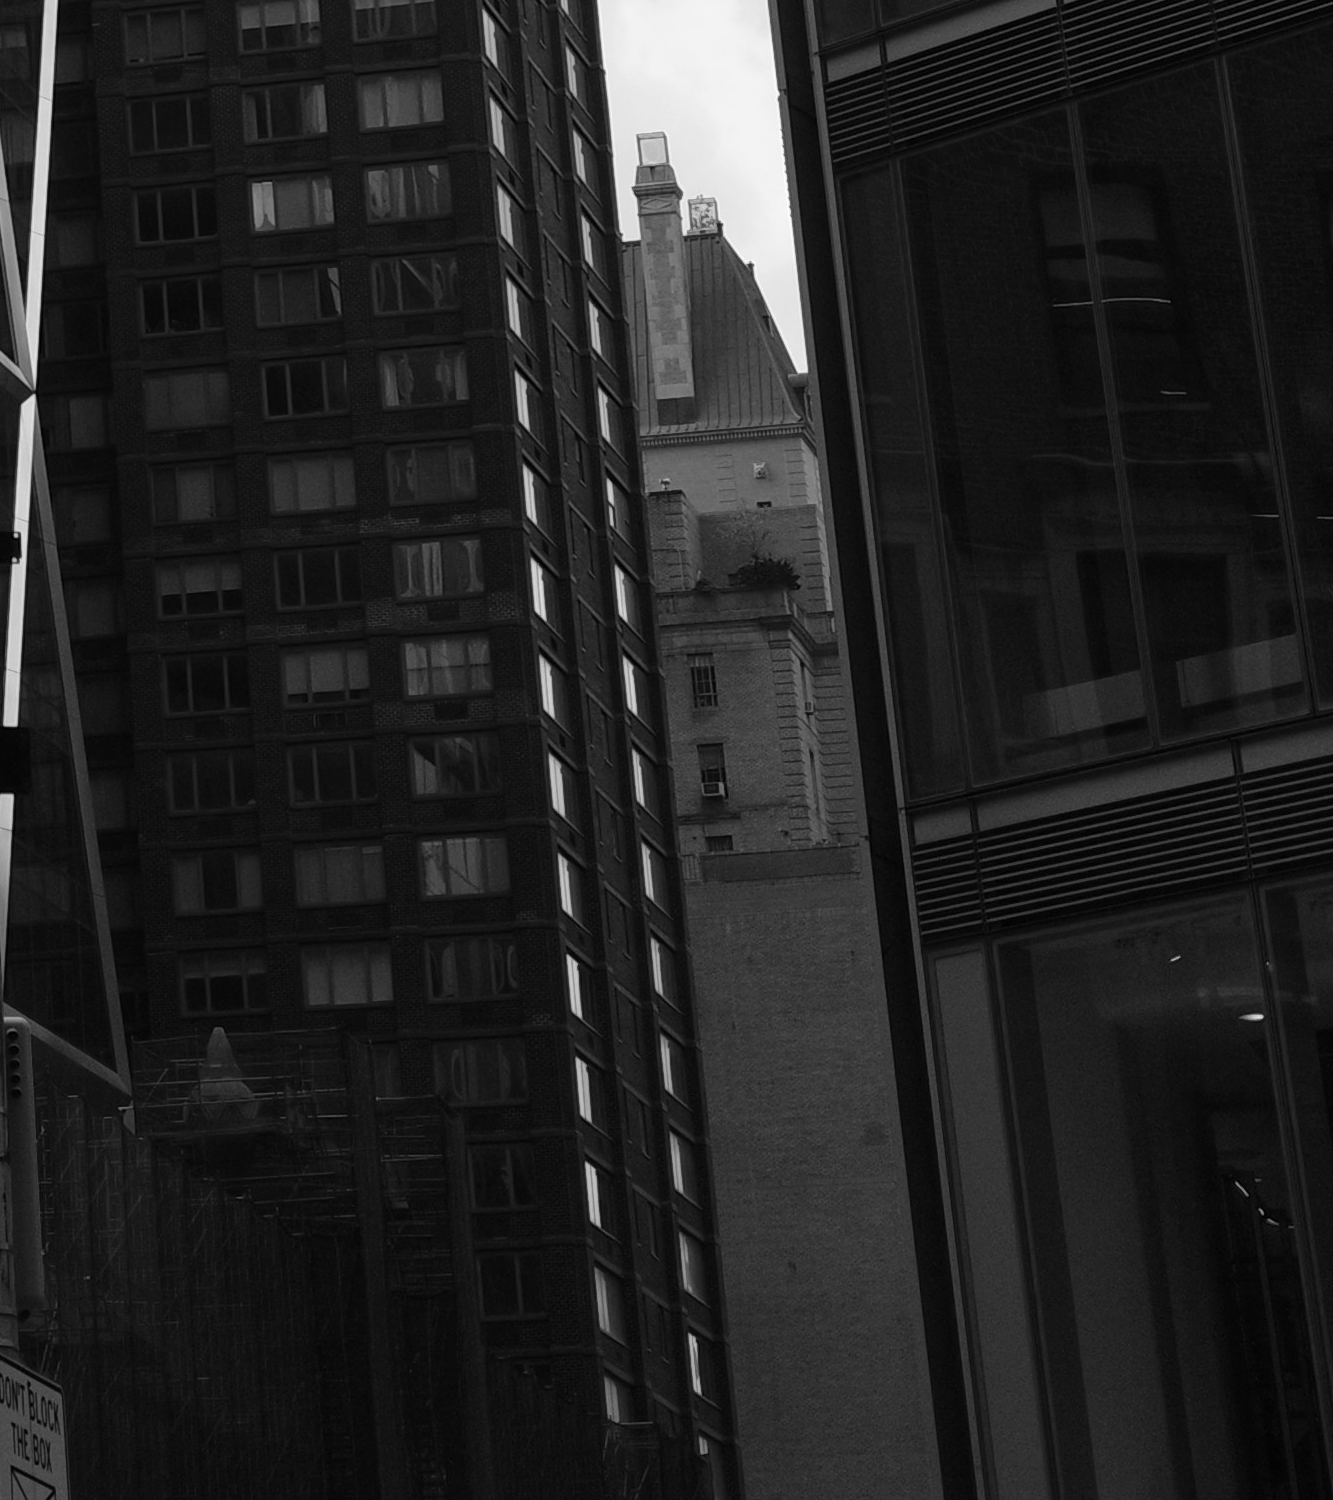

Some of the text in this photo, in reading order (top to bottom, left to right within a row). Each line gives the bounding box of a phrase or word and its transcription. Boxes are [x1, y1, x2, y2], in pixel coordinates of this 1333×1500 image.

[28, 1387, 61, 1435] BLOCK
[10, 1422, 53, 1473] THE BOX
